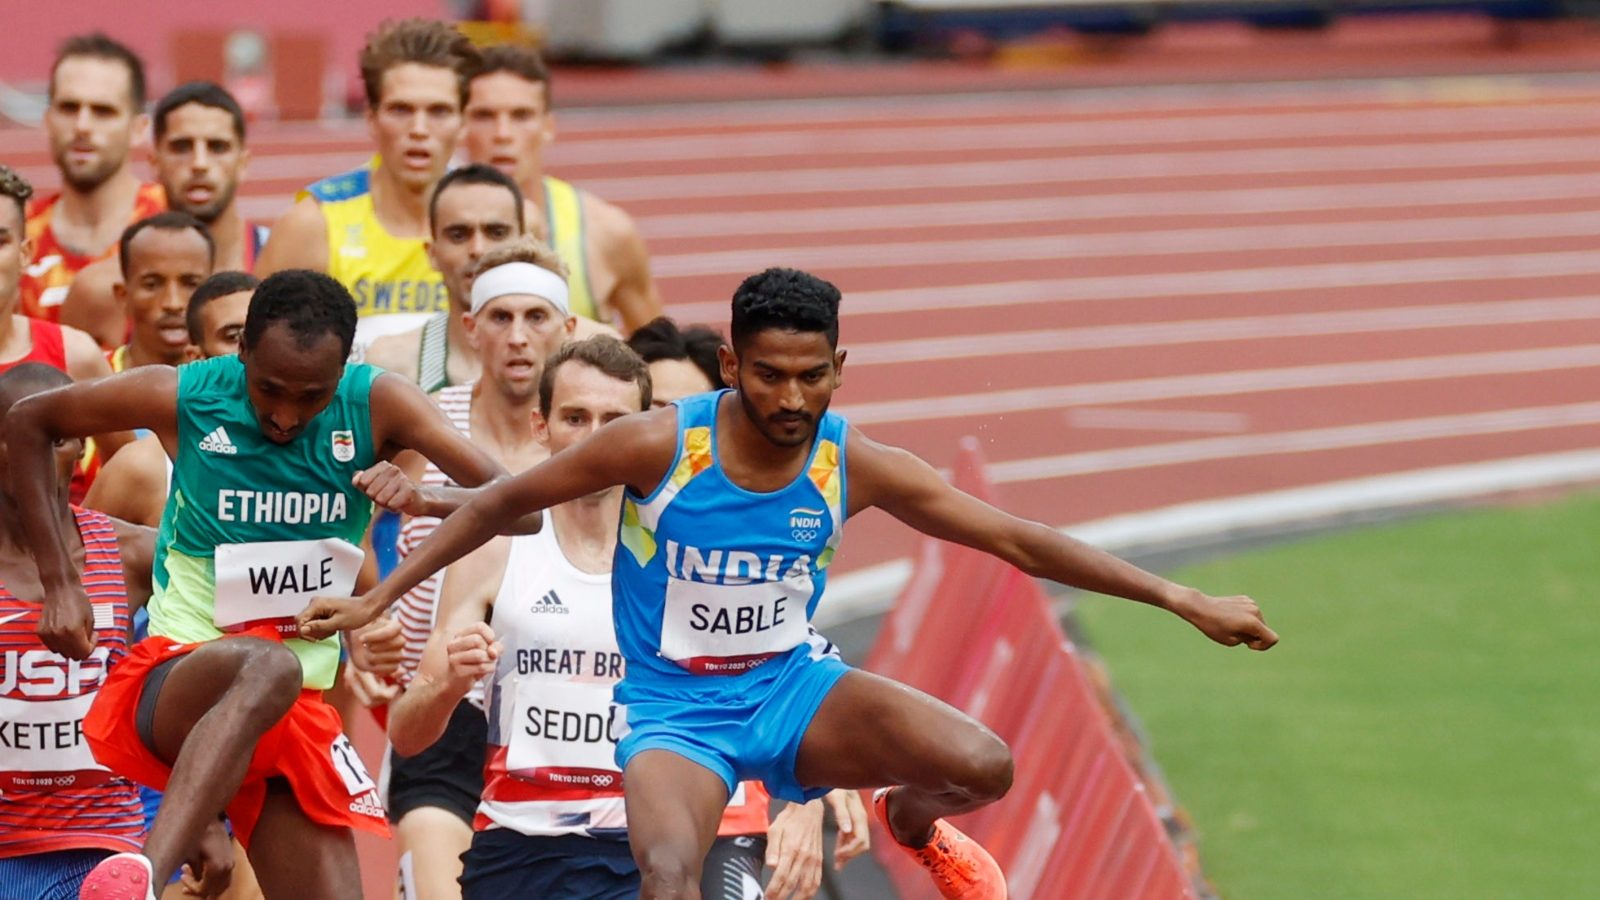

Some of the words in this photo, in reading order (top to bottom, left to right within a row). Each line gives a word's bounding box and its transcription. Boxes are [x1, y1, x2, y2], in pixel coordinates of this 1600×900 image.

[199, 441, 238, 455] adidas
[217, 488, 347, 525] ETHIOPIA
[790, 517, 821, 529] INDIA
[666, 539, 812, 584] INDIA
[248, 556, 333, 595] WALE
[530, 604, 569, 614] adidas
[689, 596, 788, 635] SABLE
[516, 648, 586, 676] GREAT
[705, 662, 728, 670] TOKYO
[12, 777, 35, 786] TOKYO
[36, 778, 53, 786] 2020
[549, 773, 572, 783] TOKYO
[572, 775, 590, 784] 2020
[349, 802, 385, 818] adidas
